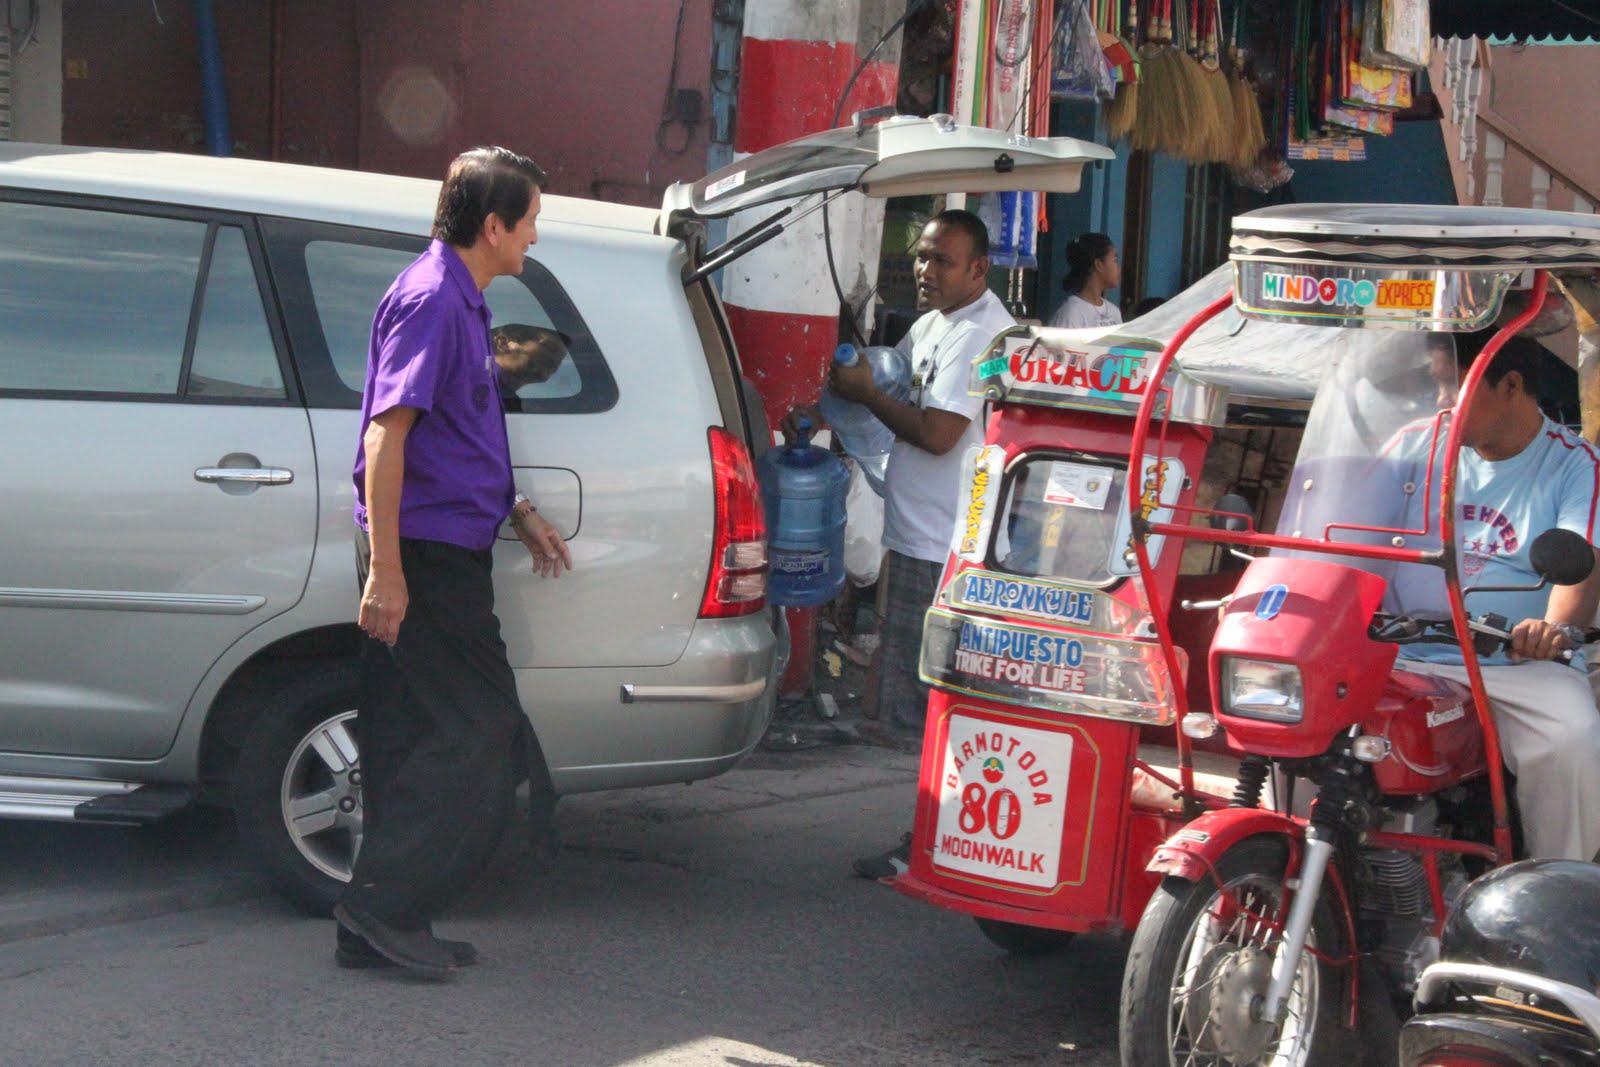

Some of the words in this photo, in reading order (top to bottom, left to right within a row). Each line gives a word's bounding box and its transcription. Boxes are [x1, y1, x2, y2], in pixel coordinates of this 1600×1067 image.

[1263, 272, 1376, 307] MINDORO
[1376, 280, 1434, 308] EXPRESS
[1009, 345, 1149, 396] GRACE
[960, 622, 1083, 668] ANTIPUESTO
[955, 649, 994, 679] TRIKE
[994, 658, 1035, 686] FOR
[1039, 666, 1087, 692] LIFE
[947, 732, 1053, 806] BARMOTODA
[959, 782, 1021, 840] 80
[941, 834, 1045, 874] MOONWALK
